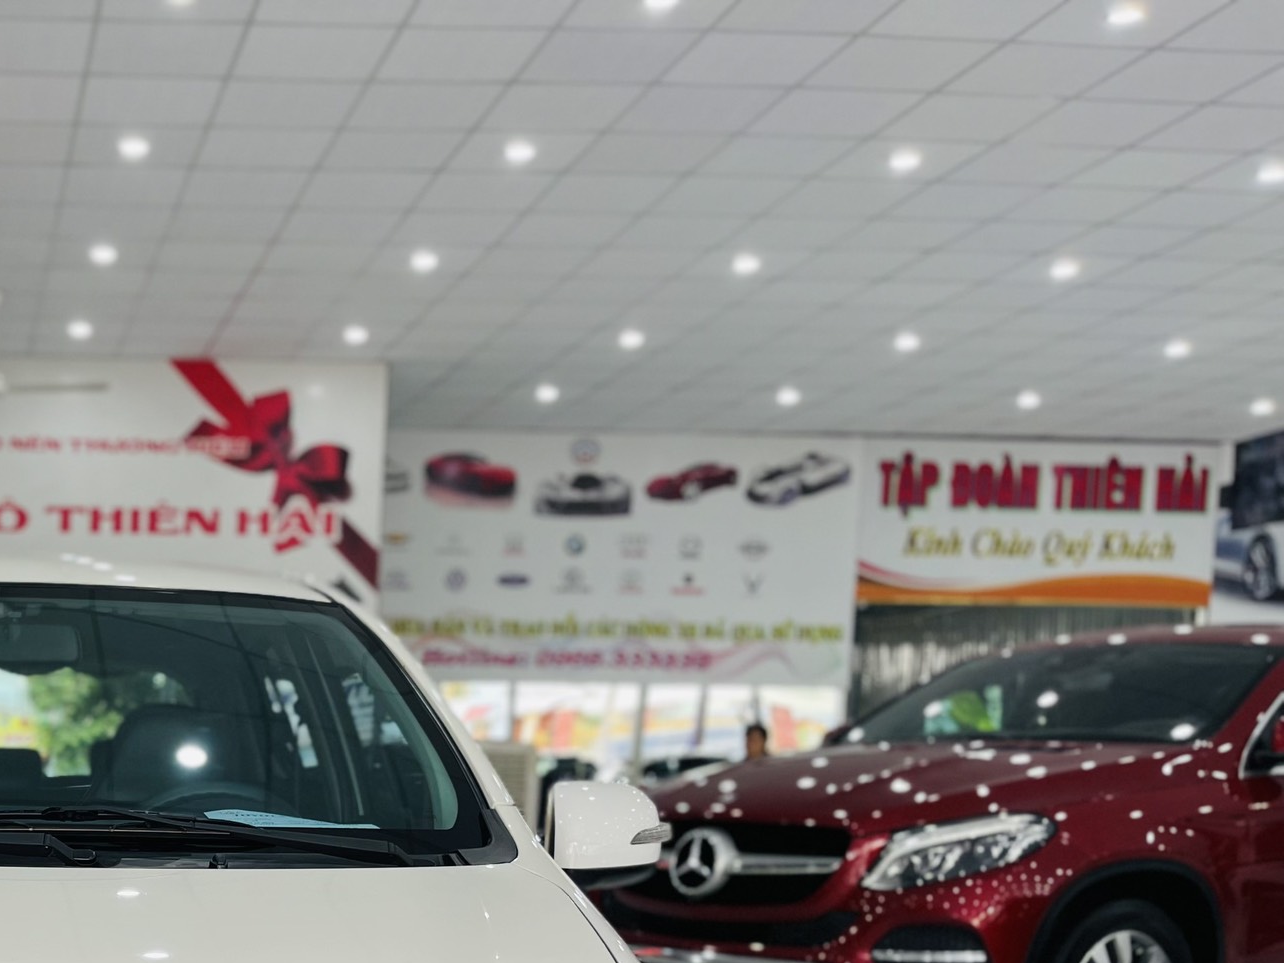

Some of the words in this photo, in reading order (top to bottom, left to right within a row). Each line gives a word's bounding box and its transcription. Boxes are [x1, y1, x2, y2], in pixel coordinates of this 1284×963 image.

[880, 451, 940, 518] TẬP
[951, 452, 1041, 509] ĐOÀN
[1052, 455, 1145, 511] THIÊN
[1156, 452, 1210, 512] HẢI
[46, 499, 222, 536] THIÊN
